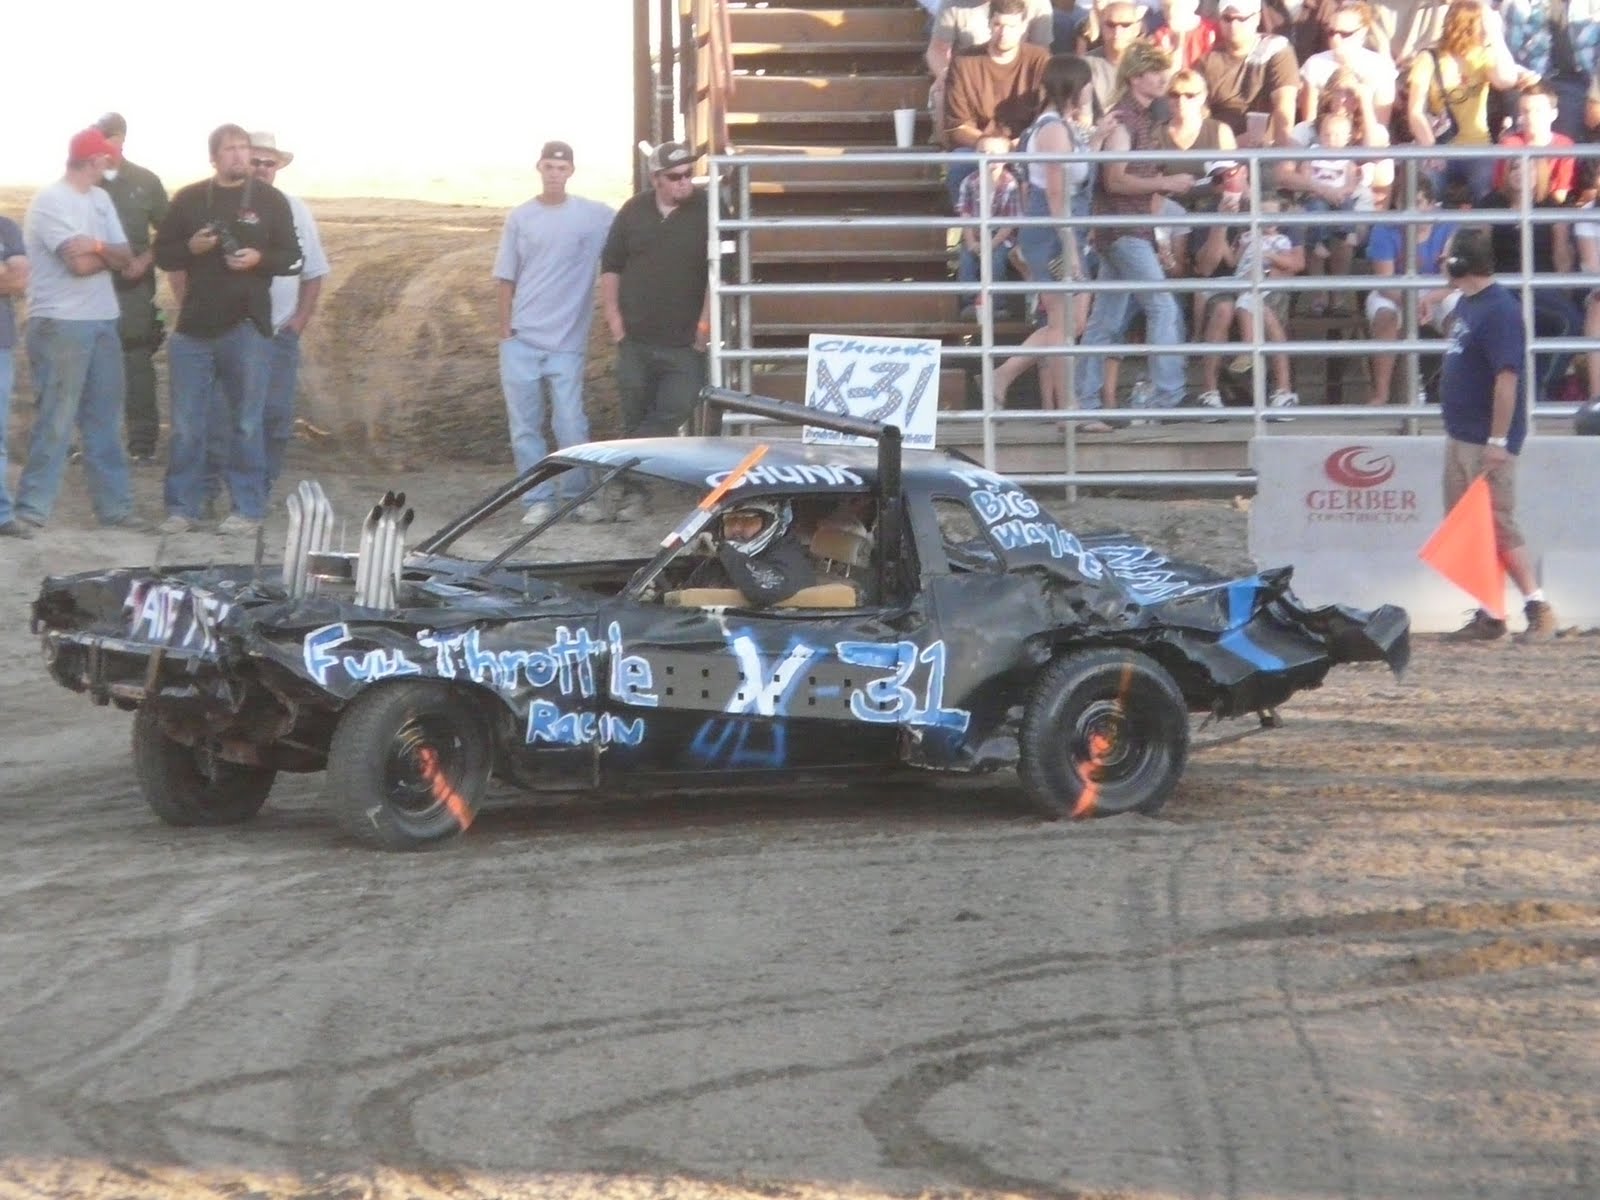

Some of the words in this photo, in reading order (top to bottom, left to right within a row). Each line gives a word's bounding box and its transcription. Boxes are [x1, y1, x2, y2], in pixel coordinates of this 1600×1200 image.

[809, 359, 936, 427] X-31
[706, 464, 863, 490] CHUNK
[1305, 489, 1417, 511] GERBER
[416, 621, 659, 707] Throttle
